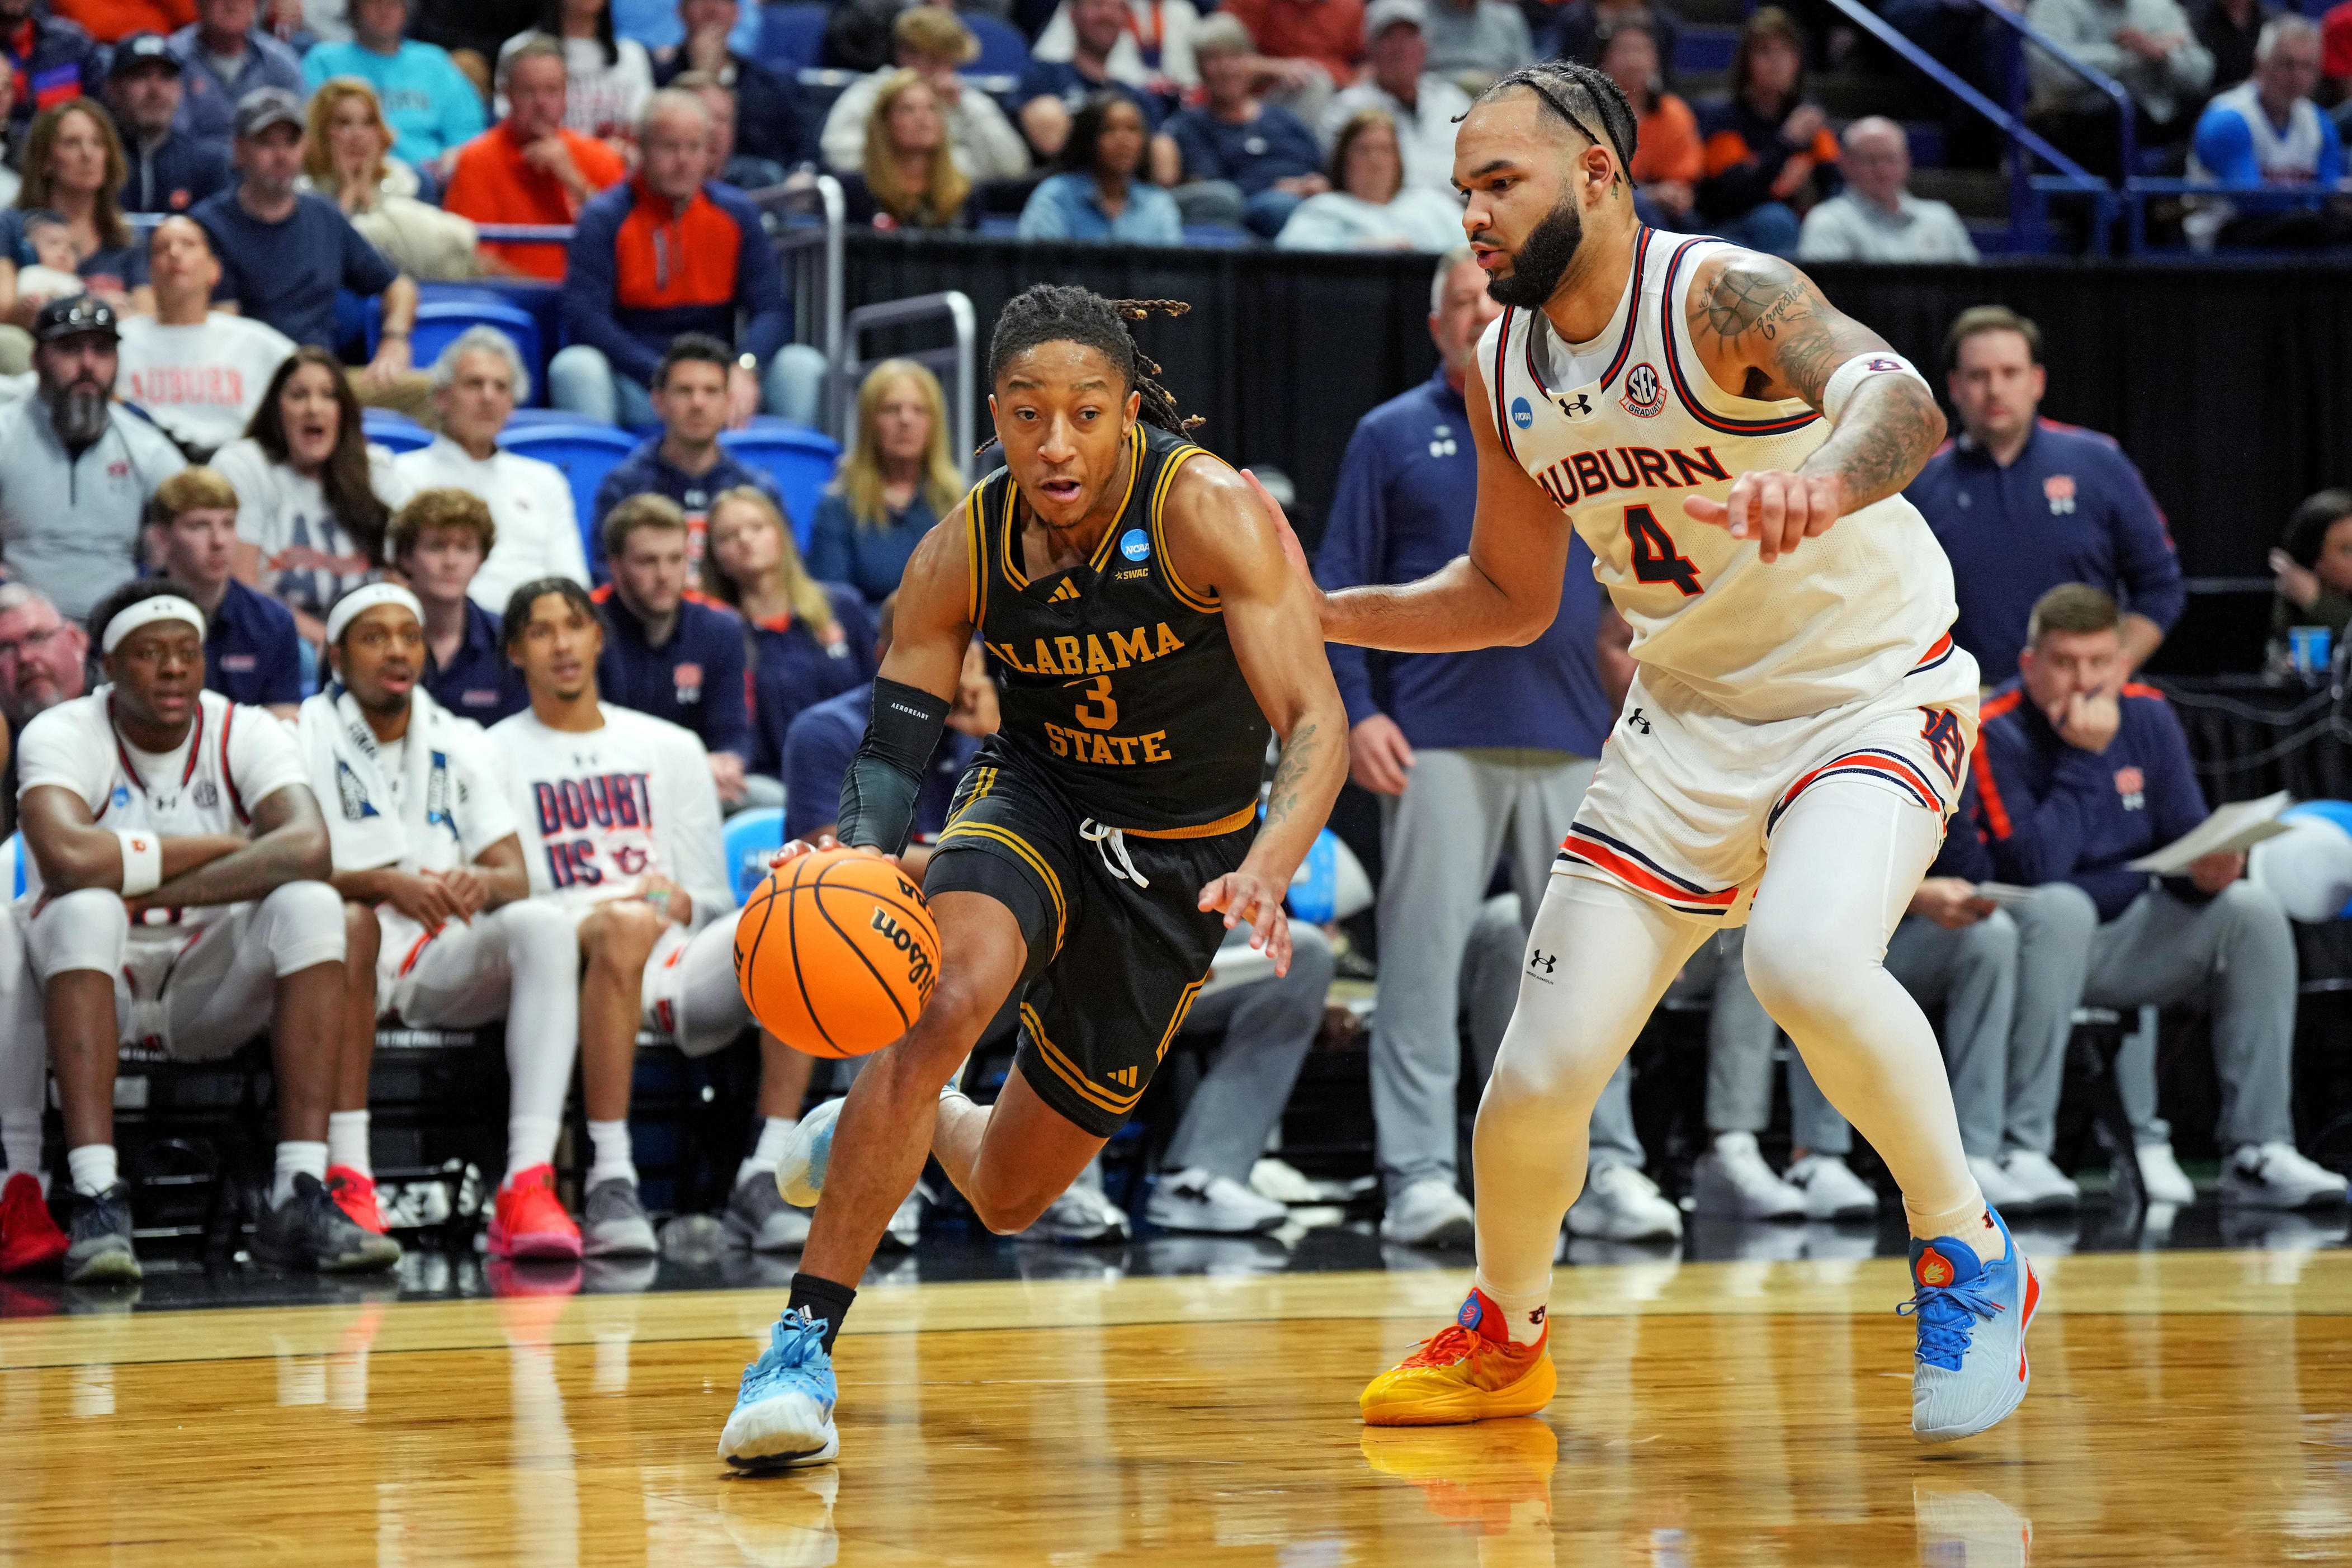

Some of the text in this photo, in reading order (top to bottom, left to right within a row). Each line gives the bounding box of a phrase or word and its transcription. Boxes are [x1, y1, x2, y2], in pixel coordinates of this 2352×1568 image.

[1628, 366, 1656, 404] SEC
[1514, 412, 1531, 421] NCAA
[1628, 398, 1663, 417] GRADUATE
[1536, 446, 1734, 509] AUBURN
[1125, 543, 1150, 555] NCAA
[1624, 504, 1705, 597] 4
[1123, 568, 1149, 580] SWAC
[891, 702, 929, 720] AEROREADY
[1062, 674, 1118, 730] 3
[1044, 722, 1172, 765] STATE
[532, 771, 652, 837] DOUBT
[546, 840, 603, 888] US
